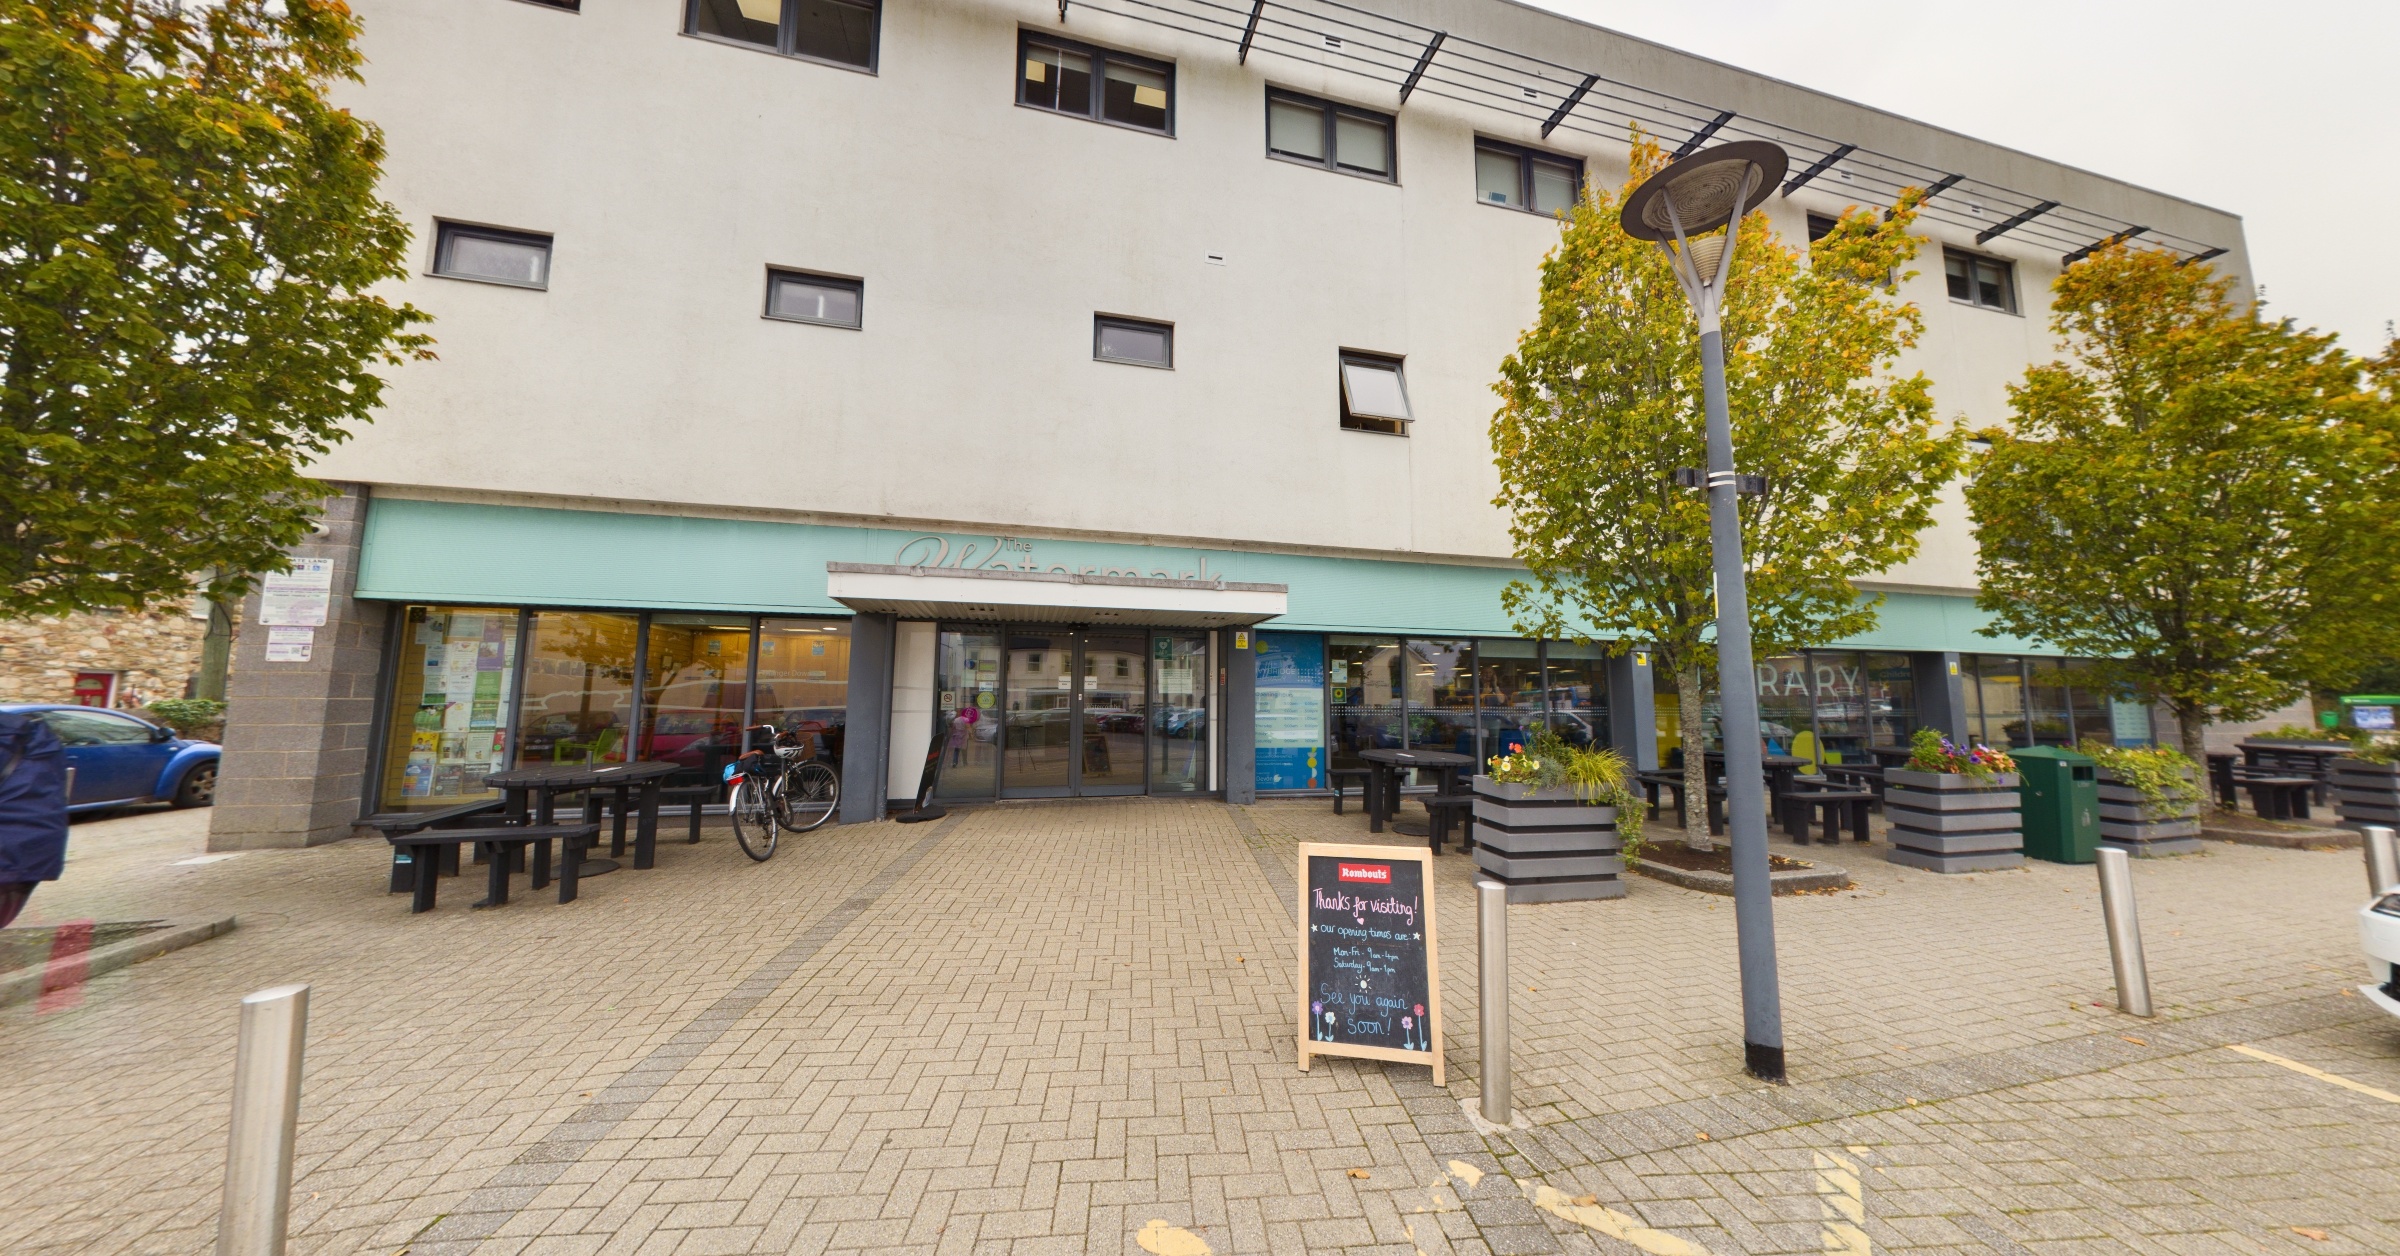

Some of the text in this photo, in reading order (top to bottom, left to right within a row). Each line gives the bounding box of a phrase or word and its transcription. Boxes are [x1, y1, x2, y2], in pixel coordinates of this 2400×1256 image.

[1003, 537, 1033, 552] The
[1342, 868, 1387, 879] Rombouts
[1312, 887, 1419, 926] Thanks for visiting!
[1337, 926, 1367, 942] opening
[1368, 927, 1392, 940] times
[1320, 982, 1409, 1018] See you again
